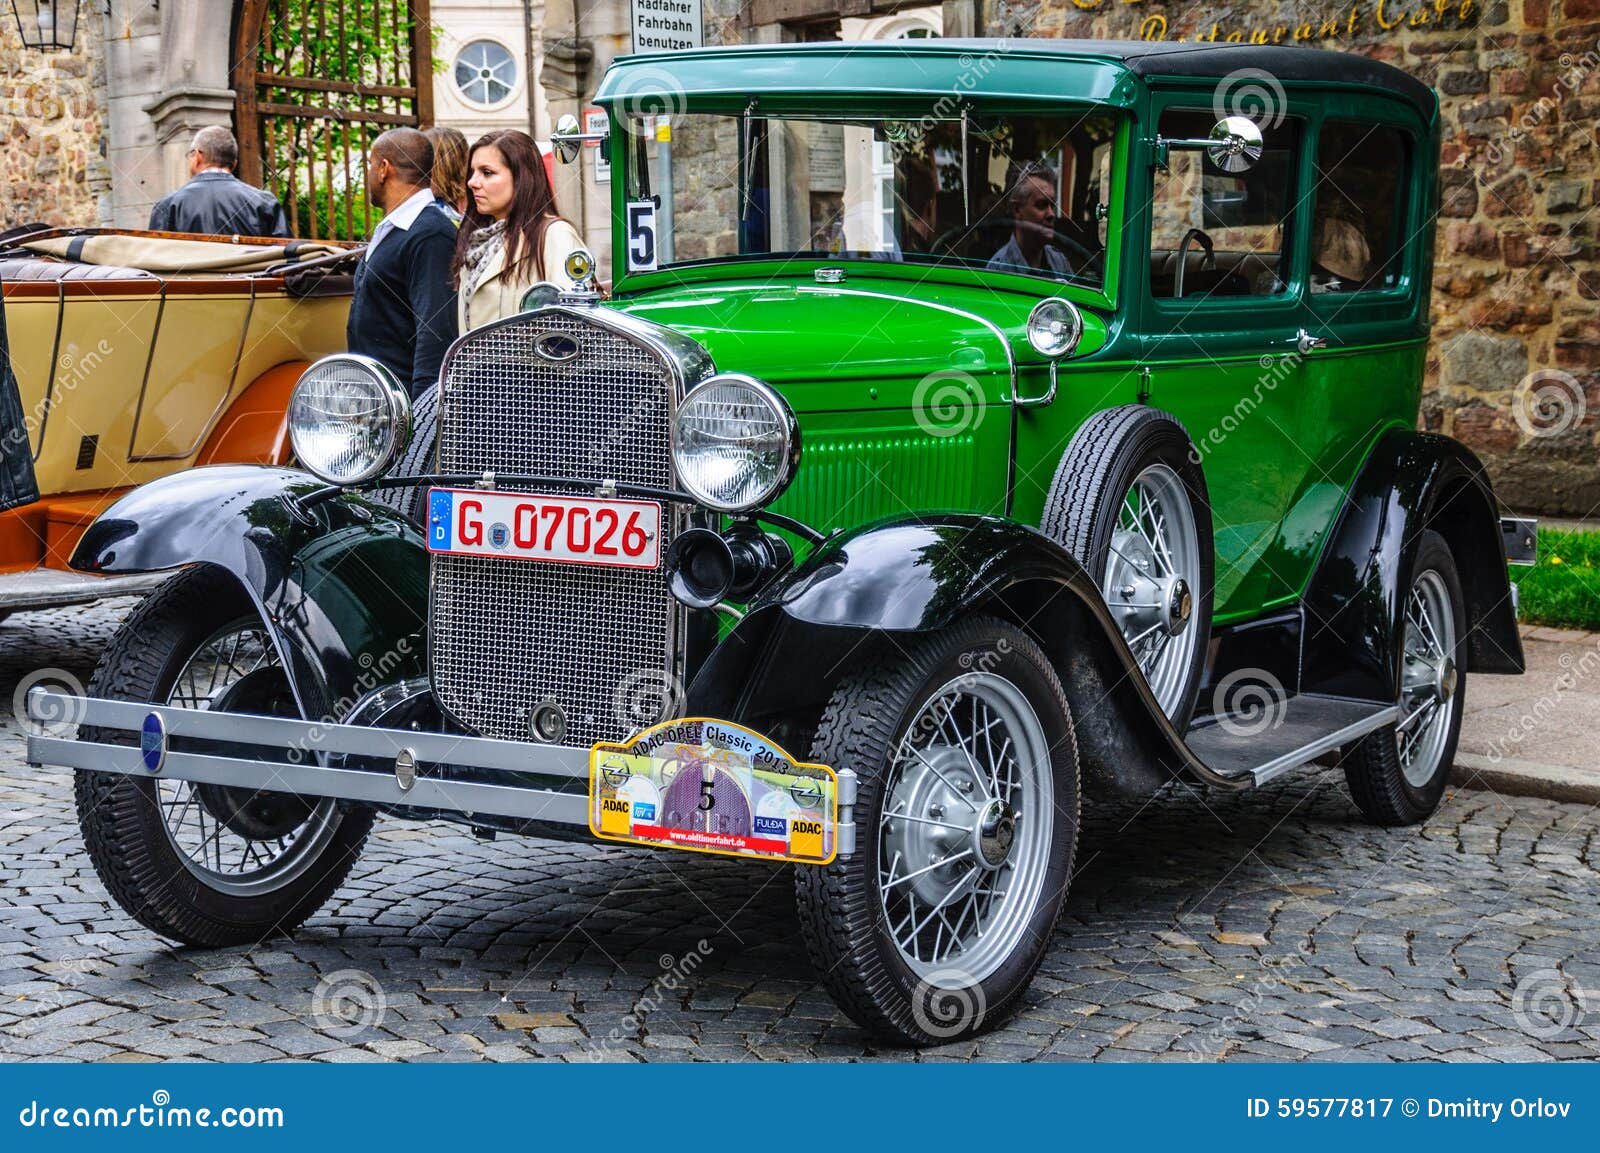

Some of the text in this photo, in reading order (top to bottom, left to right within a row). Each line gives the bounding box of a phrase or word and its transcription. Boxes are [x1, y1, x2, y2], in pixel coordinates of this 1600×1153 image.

[638, 0, 691, 13] Radfahrer
[638, 15, 693, 32] Fahrbahn
[638, 34, 693, 50] benutzen
[629, 207, 654, 265] 5
[435, 526, 445, 540] D
[458, 500, 483, 546] G
[513, 503, 647, 557] 07026
[632, 726, 789, 775] ADAC OPEL Classic 2013
[698, 782, 716, 811] 5
[603, 800, 629, 813] ADAC
[792, 821, 822, 835] ADAC
[669, 831, 746, 848] www.oldtimerfahrt.de
